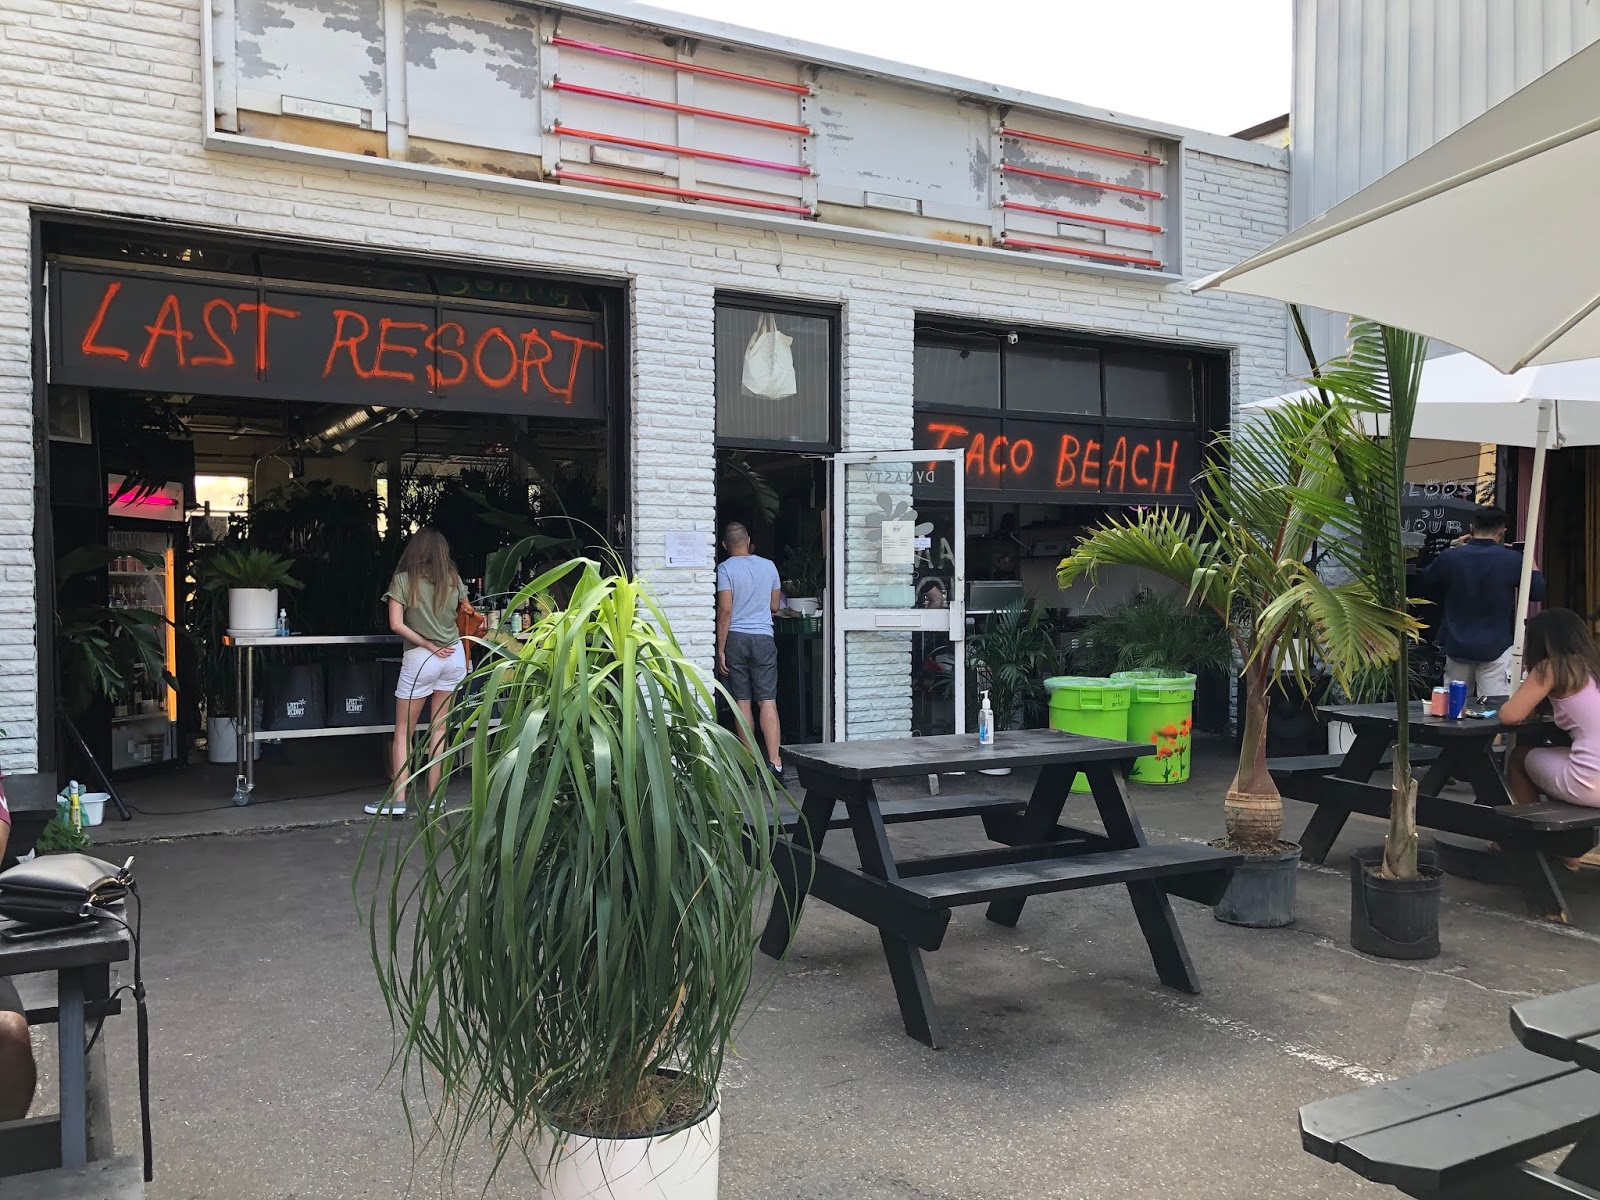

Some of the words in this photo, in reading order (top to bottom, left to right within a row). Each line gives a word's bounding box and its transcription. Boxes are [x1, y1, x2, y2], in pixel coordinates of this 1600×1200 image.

[82, 282, 301, 375] LAST
[322, 309, 604, 403] RESORT
[927, 422, 1034, 476] TACO
[1055, 433, 1179, 494] BEACH
